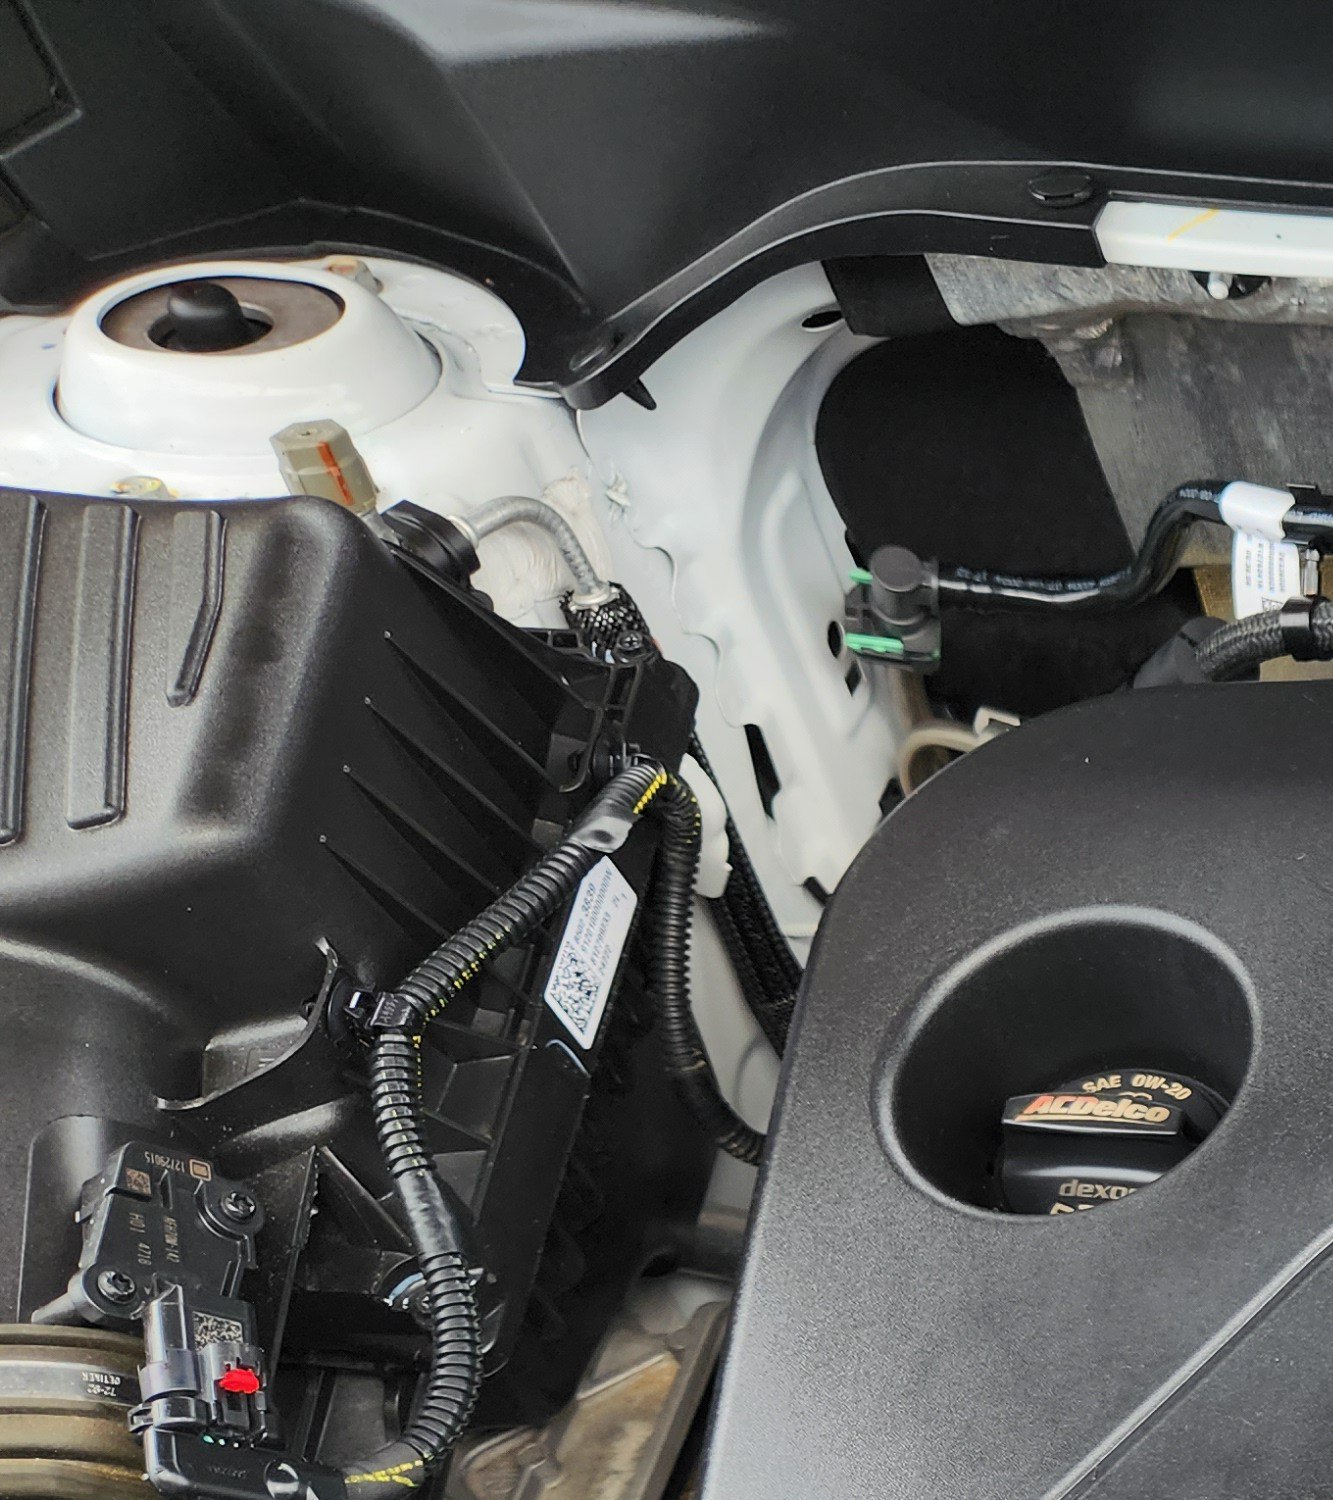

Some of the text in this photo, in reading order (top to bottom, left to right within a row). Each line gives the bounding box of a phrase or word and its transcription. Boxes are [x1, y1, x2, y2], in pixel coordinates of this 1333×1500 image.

[1082, 1074, 1192, 1100] SAE 0W-20
[1023, 1094, 1171, 1123] ACDelco
